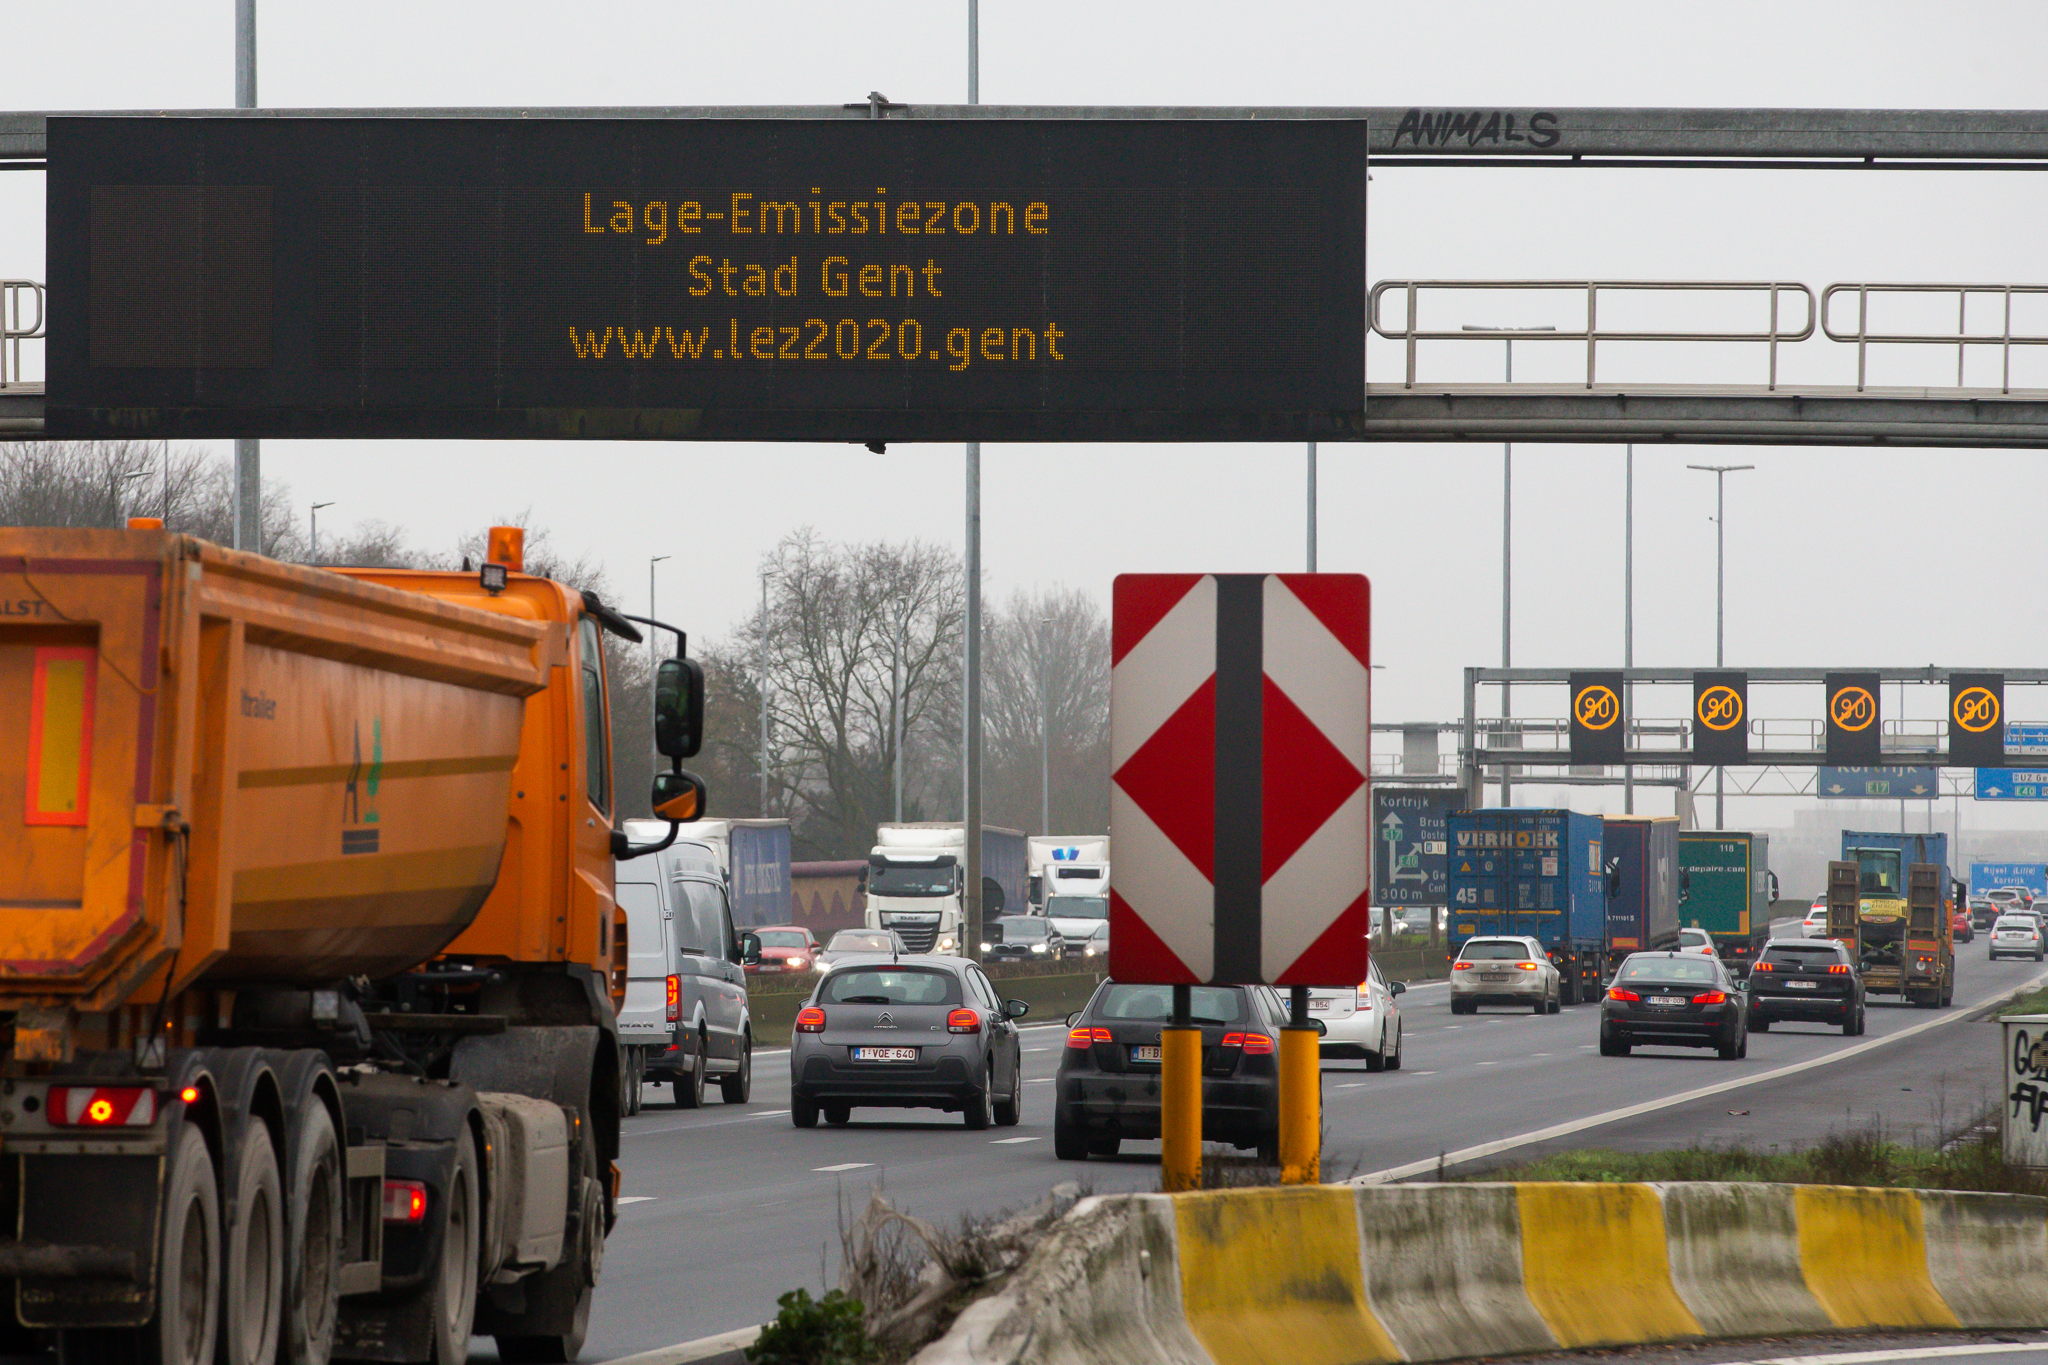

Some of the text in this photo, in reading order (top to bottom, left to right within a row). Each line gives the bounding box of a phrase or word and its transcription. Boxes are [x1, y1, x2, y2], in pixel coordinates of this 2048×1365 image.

[1391, 108, 1561, 149] ANIMALS
[584, 187, 1049, 245] Lage-Emissiezone
[688, 255, 943, 297] Stad Gent
[569, 318, 1065, 372] www.lez2020.gent
[0, 600, 44, 616] LST
[2020, 774, 2033, 782] UZ
[1867, 782, 1888, 793] E17
[2016, 786, 2035, 796] E40
[1380, 796, 1430, 810] Kortrijk
[1384, 829, 1402, 840] E17
[1457, 831, 1560, 847] VERHOEK
[1719, 844, 1735, 853] 118
[1400, 857, 1418, 868] E40
[1993, 877, 2025, 885] Kortrijk
[1380, 888, 1424, 901] 300 m
[1456, 887, 1478, 904] 45
[860, 1048, 915, 1059] 1-VQE-640
[1140, 1047, 1163, 1058] 1-B
